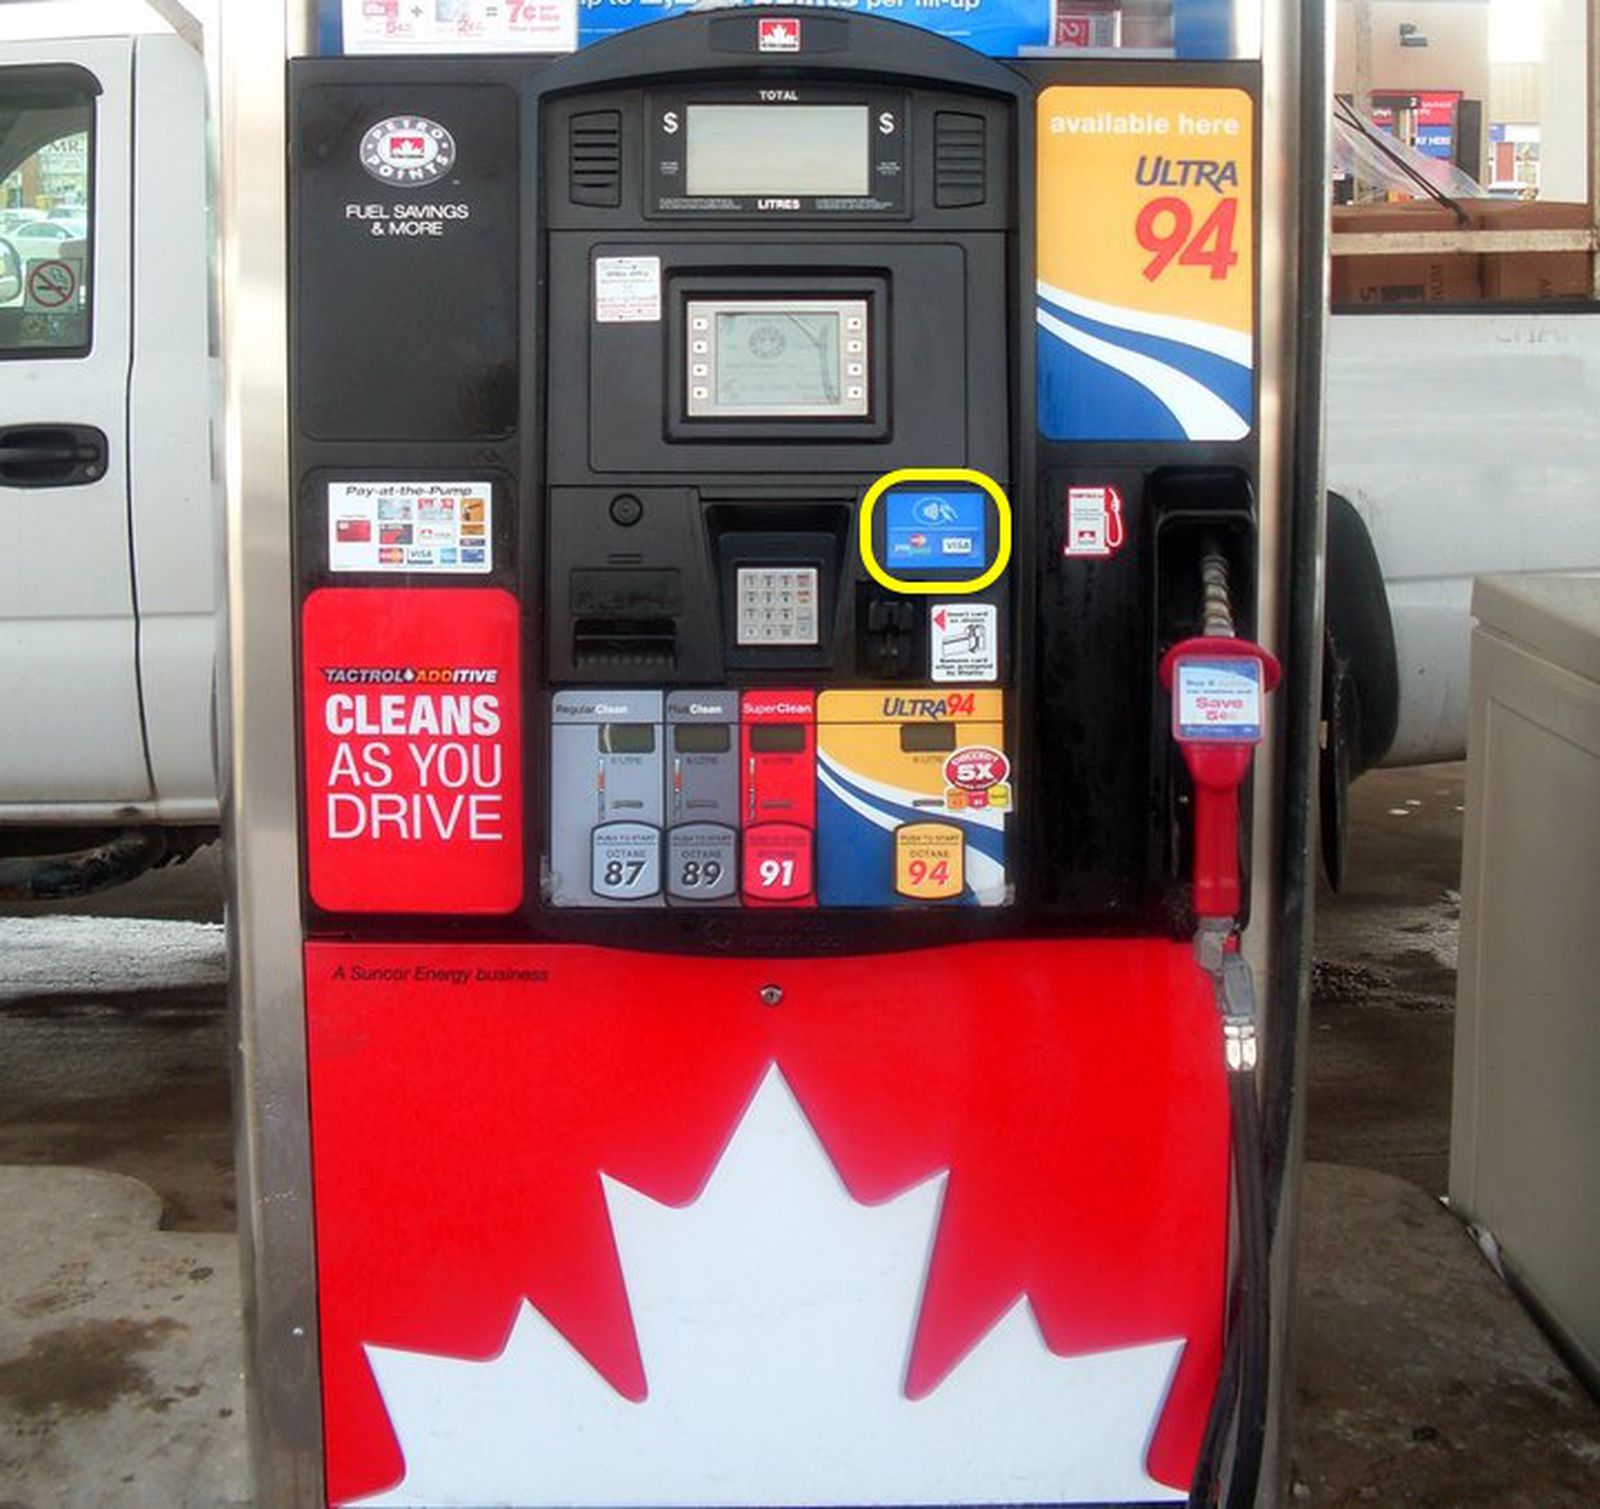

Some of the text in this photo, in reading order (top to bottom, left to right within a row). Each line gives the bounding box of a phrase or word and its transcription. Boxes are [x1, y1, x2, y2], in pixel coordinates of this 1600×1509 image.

[759, 90, 799, 101] TOTAL
[662, 112, 679, 135] $
[878, 112, 895, 135] $
[1050, 112, 1241, 136] available here
[365, 154, 449, 181] POINTS
[1134, 155, 1239, 194] ULTRA
[345, 203, 470, 219] FUEL SAVINGS
[757, 199, 801, 211] LITRES
[370, 221, 444, 237] & MORE
[1134, 195, 1239, 282] 94
[323, 668, 498, 684] TACTROL ADDITIVE
[742, 702, 813, 716] SuperClean
[1195, 696, 1244, 709] Save
[325, 693, 501, 737] CLEANS
[328, 742, 502, 788] AS YOU
[957, 763, 993, 781] 5X
[328, 794, 503, 840] DRIVE
[606, 848, 647, 859] OCTANE
[681, 848, 722, 859] OCTANE
[909, 848, 949, 859] OCTANE
[604, 859, 647, 888] 87
[682, 859, 724, 888] 89
[759, 858, 795, 888] 91
[908, 859, 950, 887] 94
[332, 966, 550, 984] A Suncor Energy business
